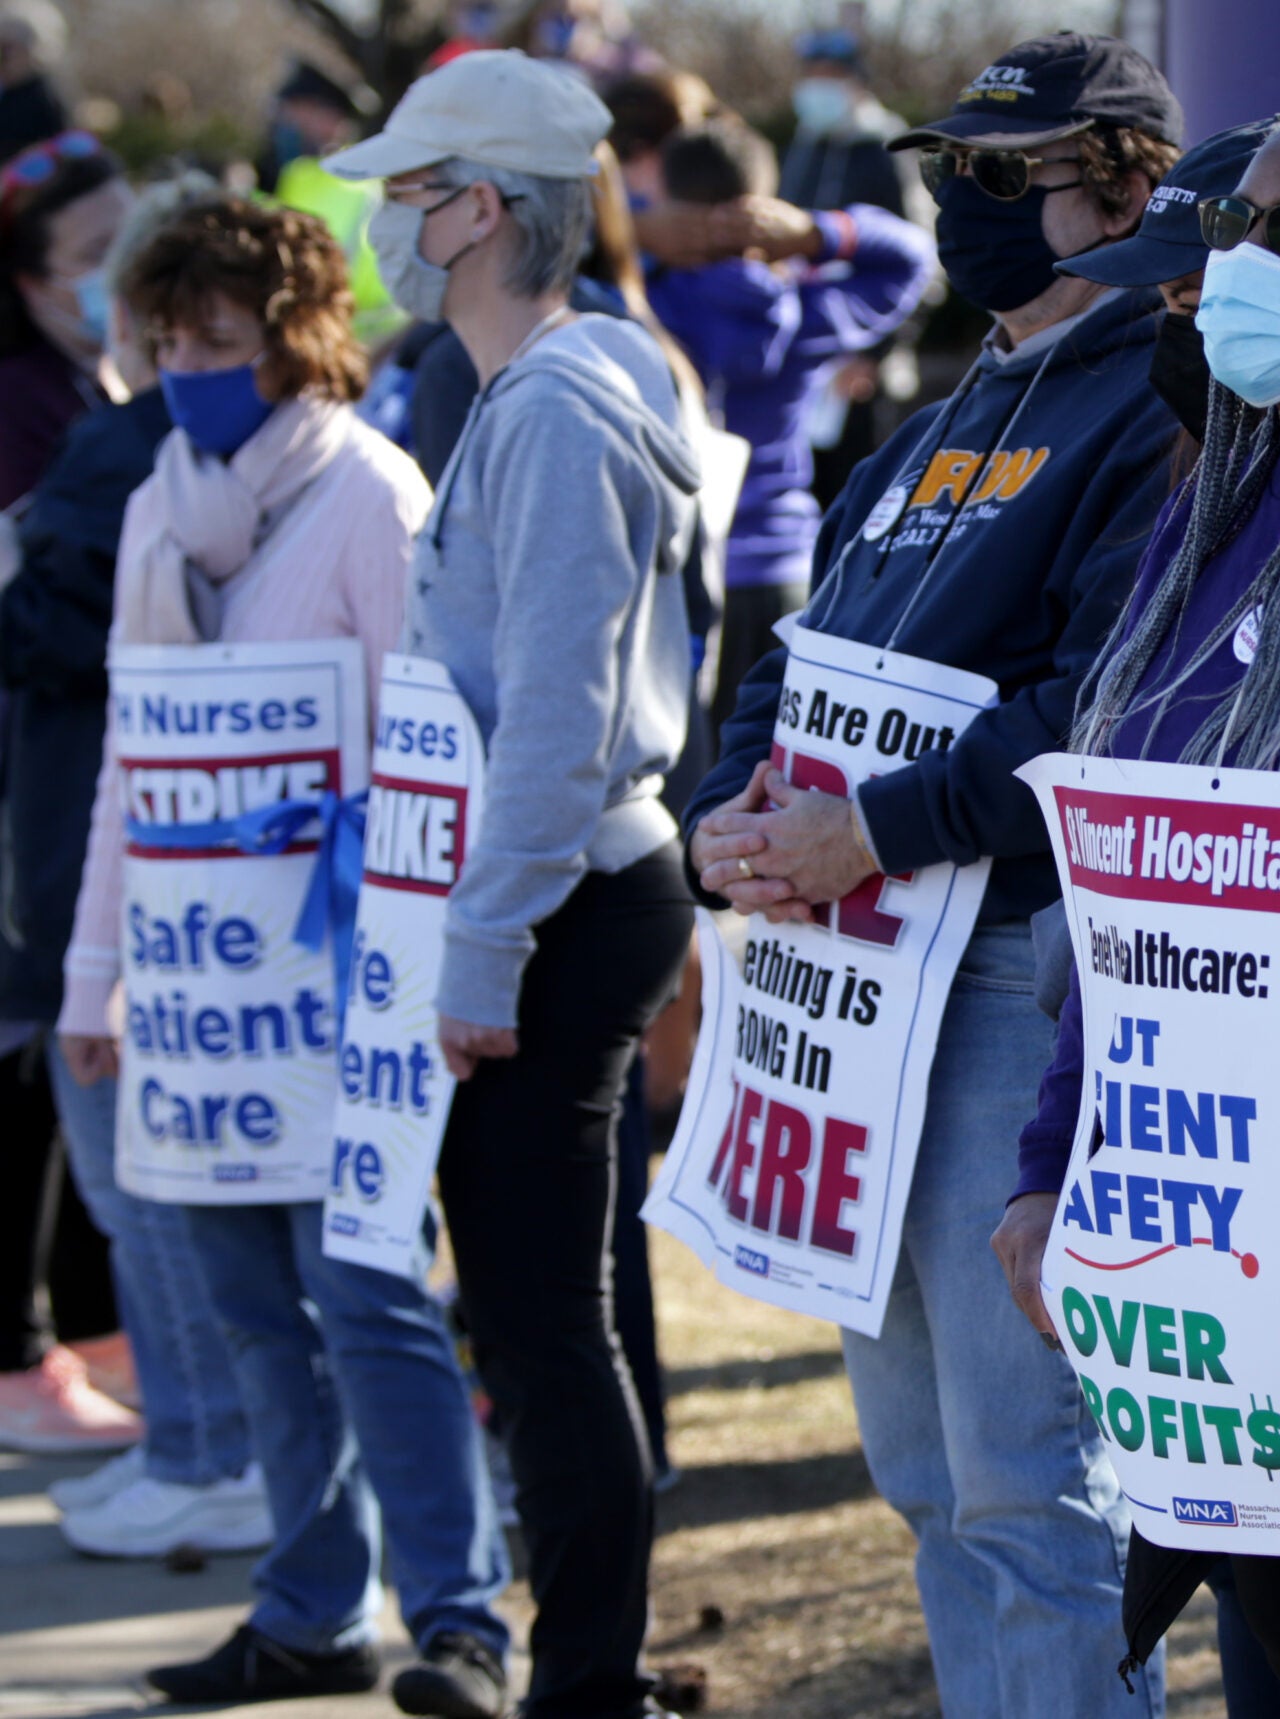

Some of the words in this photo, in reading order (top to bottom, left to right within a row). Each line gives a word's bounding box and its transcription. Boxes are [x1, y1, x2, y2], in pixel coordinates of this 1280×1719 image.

[141, 694, 319, 735] Nurses
[805, 687, 868, 747] Are
[875, 707, 955, 763] Out
[1074, 807, 1136, 877] Vincent
[130, 902, 260, 968] Safe
[1110, 925, 1270, 999] Healthcare:
[744, 938, 834, 1020] ething
[837, 965, 882, 1027] is
[793, 1029, 833, 1094] In
[140, 1075, 277, 1142] Care
[1101, 1079, 1257, 1164] IENT
[1062, 1286, 1234, 1385] OVER
[1174, 1499, 1230, 1520] MNA
[1239, 1512, 1267, 1521] Nurses
